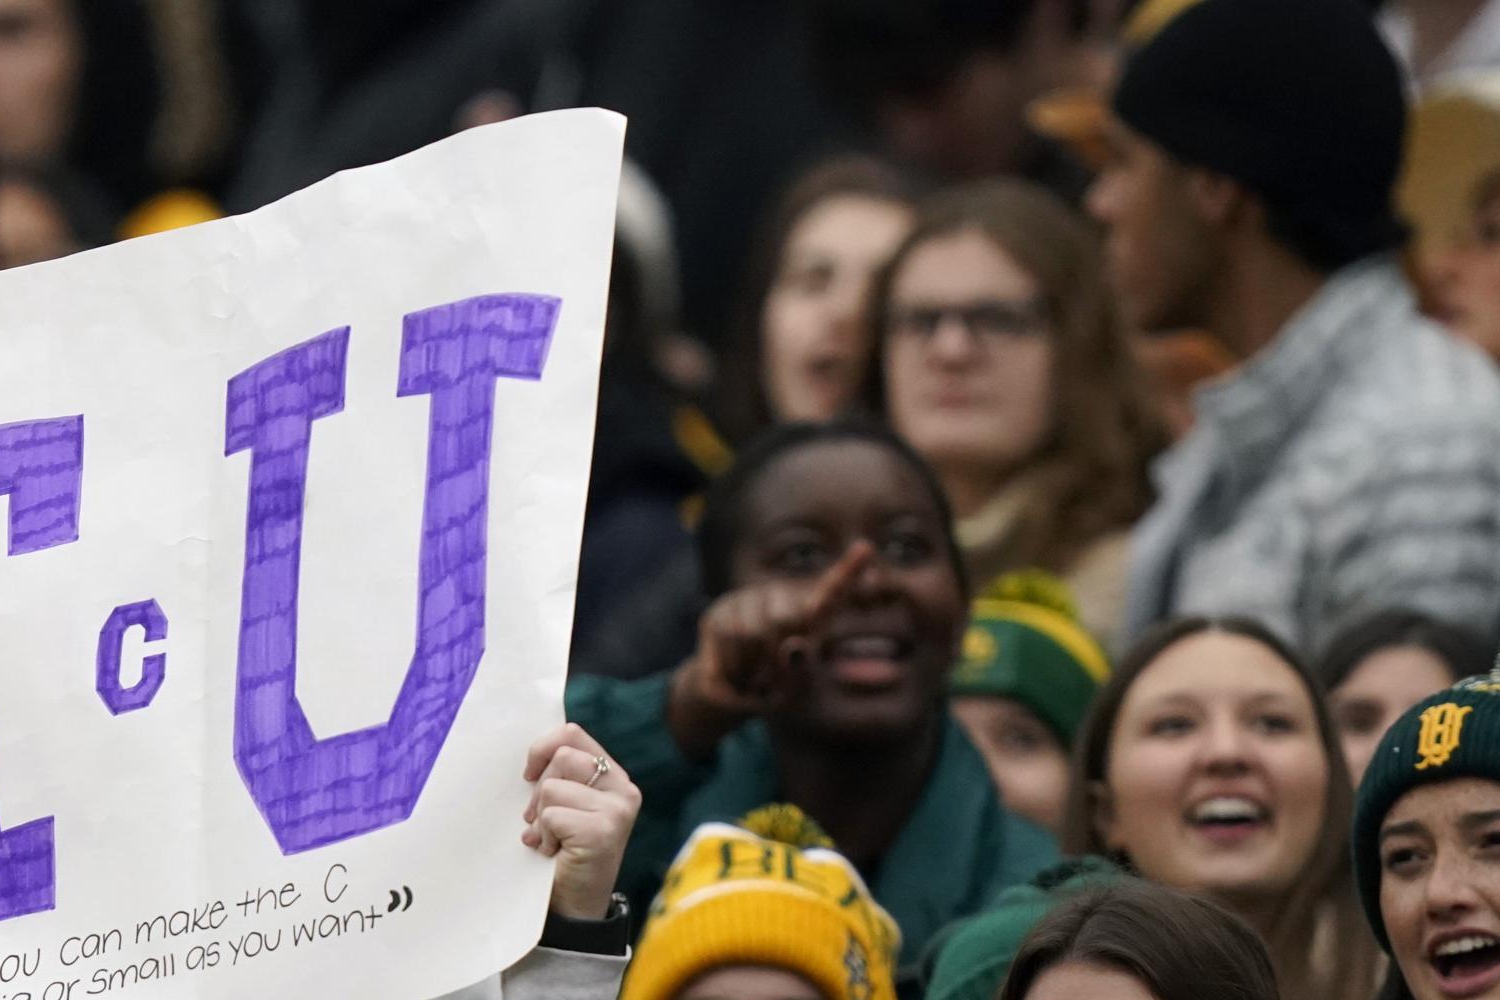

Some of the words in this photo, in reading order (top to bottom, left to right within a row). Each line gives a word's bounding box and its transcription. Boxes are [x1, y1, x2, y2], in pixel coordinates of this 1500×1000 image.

[59, 928, 123, 967] can
[134, 900, 230, 945] make
[235, 882, 302, 918] the
[323, 863, 349, 904] C
[185, 941, 221, 971] as
[227, 928, 282, 966] you
